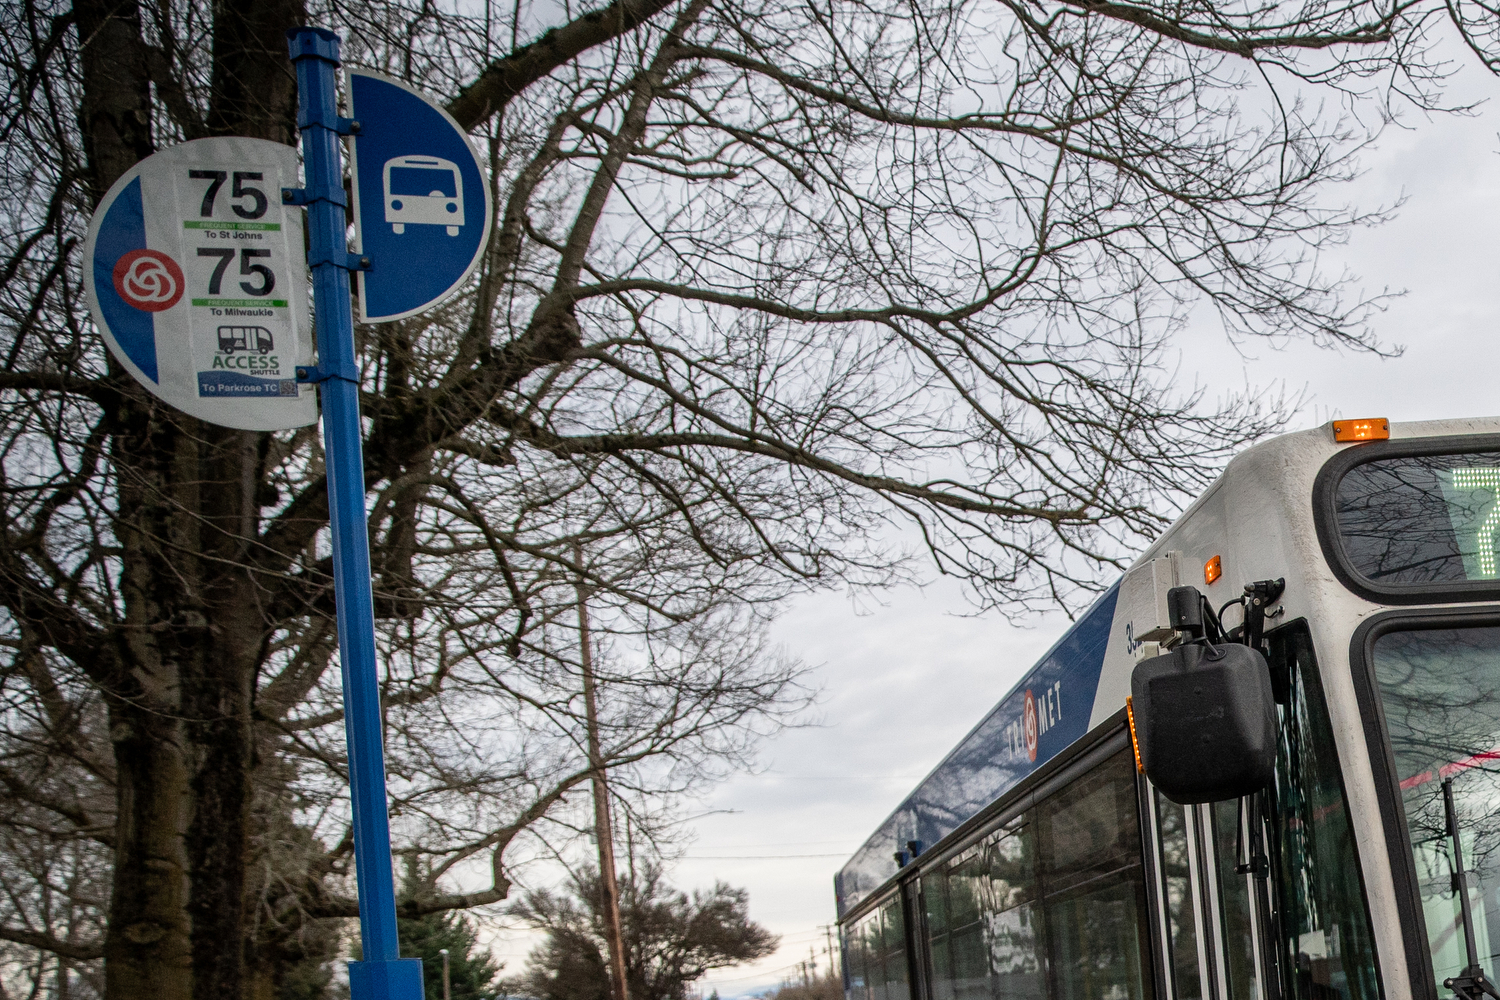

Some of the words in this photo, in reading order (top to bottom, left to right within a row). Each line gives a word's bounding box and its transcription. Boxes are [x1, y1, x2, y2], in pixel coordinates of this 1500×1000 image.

[188, 169, 268, 220] 75
[204, 231, 217, 239] To
[219, 231, 231, 239] St
[232, 231, 263, 240] Johns
[196, 247, 276, 297] 75
[210, 308, 222, 316] To
[225, 308, 274, 317] Milwaukie
[212, 355, 280, 369] ACCESS
[202, 383, 216, 392] To
[218, 383, 262, 392] Parkrose
[263, 383, 278, 392] TC
[1006, 714, 1025, 761] TRI
[1038, 680, 1062, 736] MET
